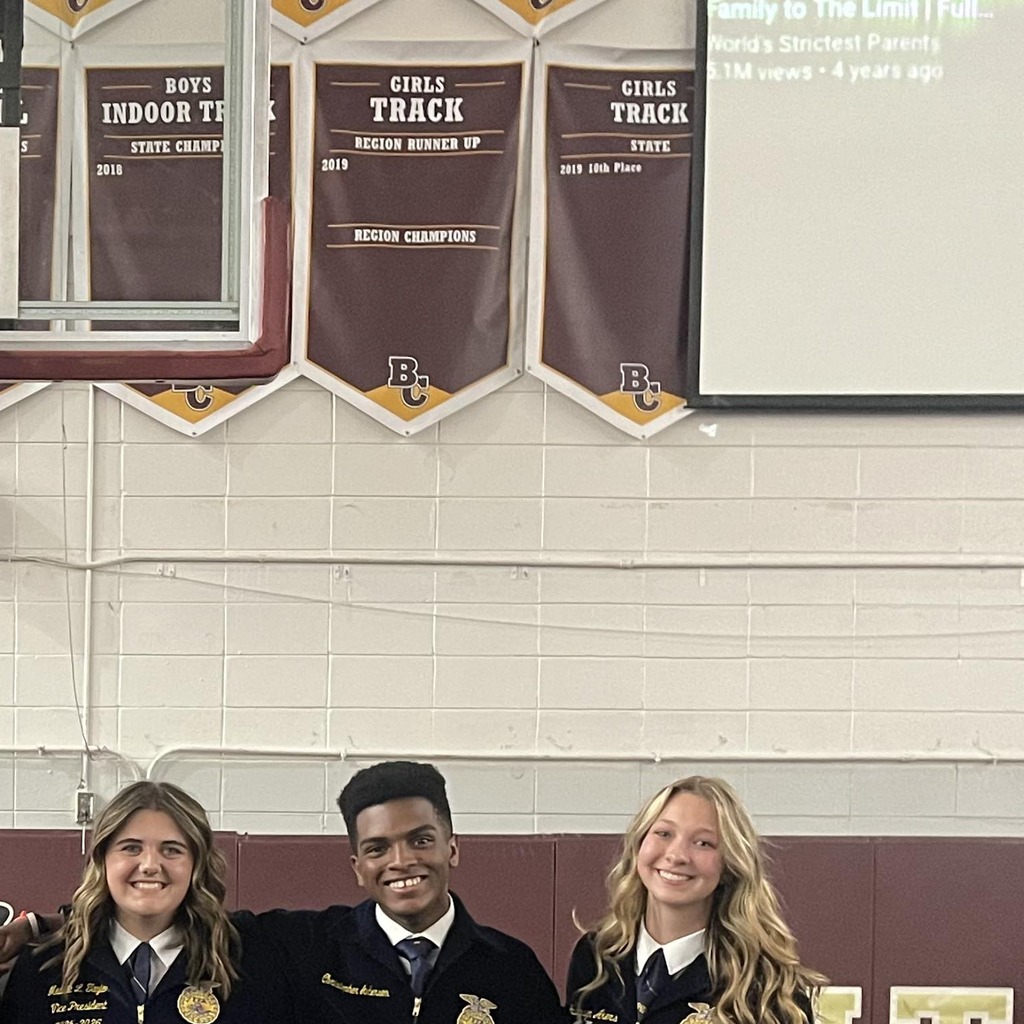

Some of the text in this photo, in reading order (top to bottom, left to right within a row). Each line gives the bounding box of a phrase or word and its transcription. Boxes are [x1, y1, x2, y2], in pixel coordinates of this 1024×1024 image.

[817, 0, 857, 19] The
[779, 34, 861, 53] Strictest
[867, 32, 941, 54] Parents
[758, 64, 812, 81] views
[832, 60, 844, 79] 4
[849, 63, 901, 83] years
[908, 64, 944, 83] ago
[165, 77, 212, 94] BOYS
[390, 76, 445, 93] GIRLS
[622, 80, 676, 97] GIRLS
[102, 101, 191, 124] INDOOR
[370, 97, 464, 122] TRACK
[610, 102, 689, 124] TRACK
[131, 140, 170, 153] STATE
[355, 136, 481, 150] REGION RUNNER UP
[631, 140, 671, 153] STATE
[97, 164, 123, 176] 2018
[322, 158, 349, 171] 2019
[560, 162, 643, 175] 2019 10th Place
[354, 229, 477, 243] REGION CHAMPIONS
[67, 999, 108, 1011] President
